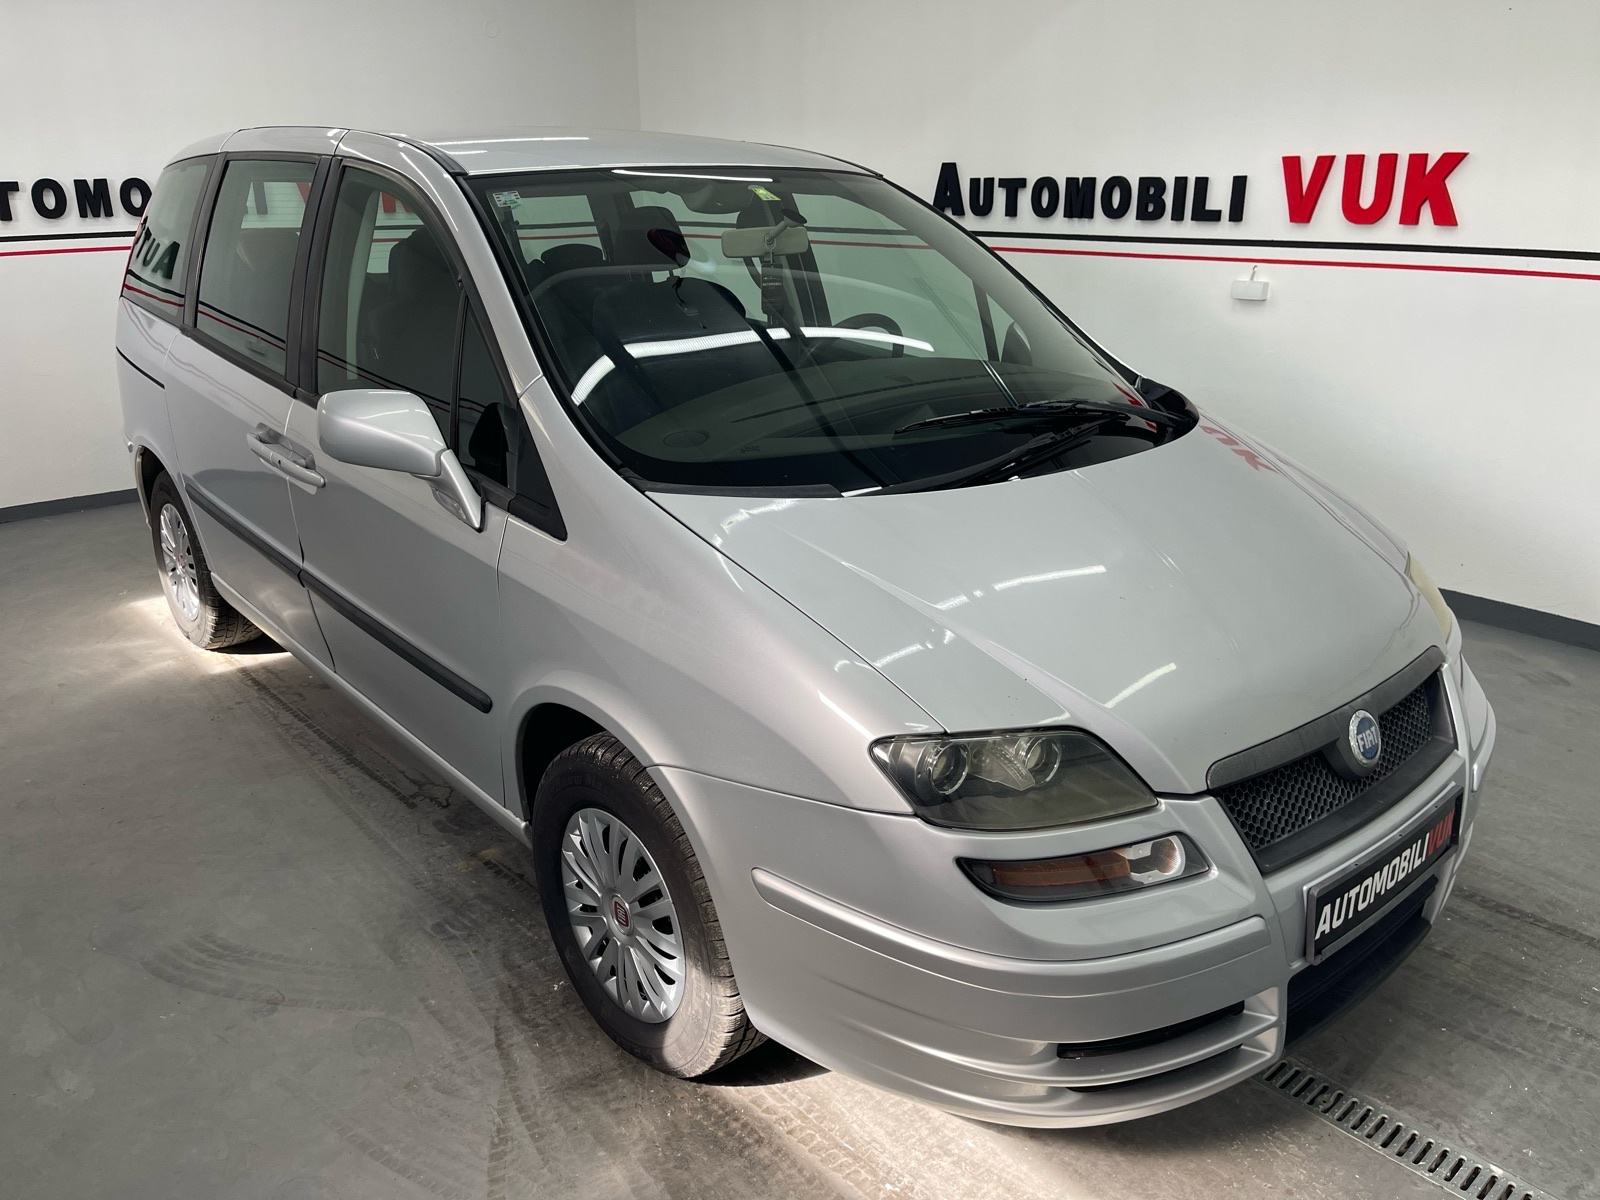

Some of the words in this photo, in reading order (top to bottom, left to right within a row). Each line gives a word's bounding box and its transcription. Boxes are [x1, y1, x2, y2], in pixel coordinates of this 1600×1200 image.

[932, 161, 1248, 222] AUTOMOBILI
[1281, 152, 1470, 227] VUK
[1357, 726, 1378, 753] FIAT
